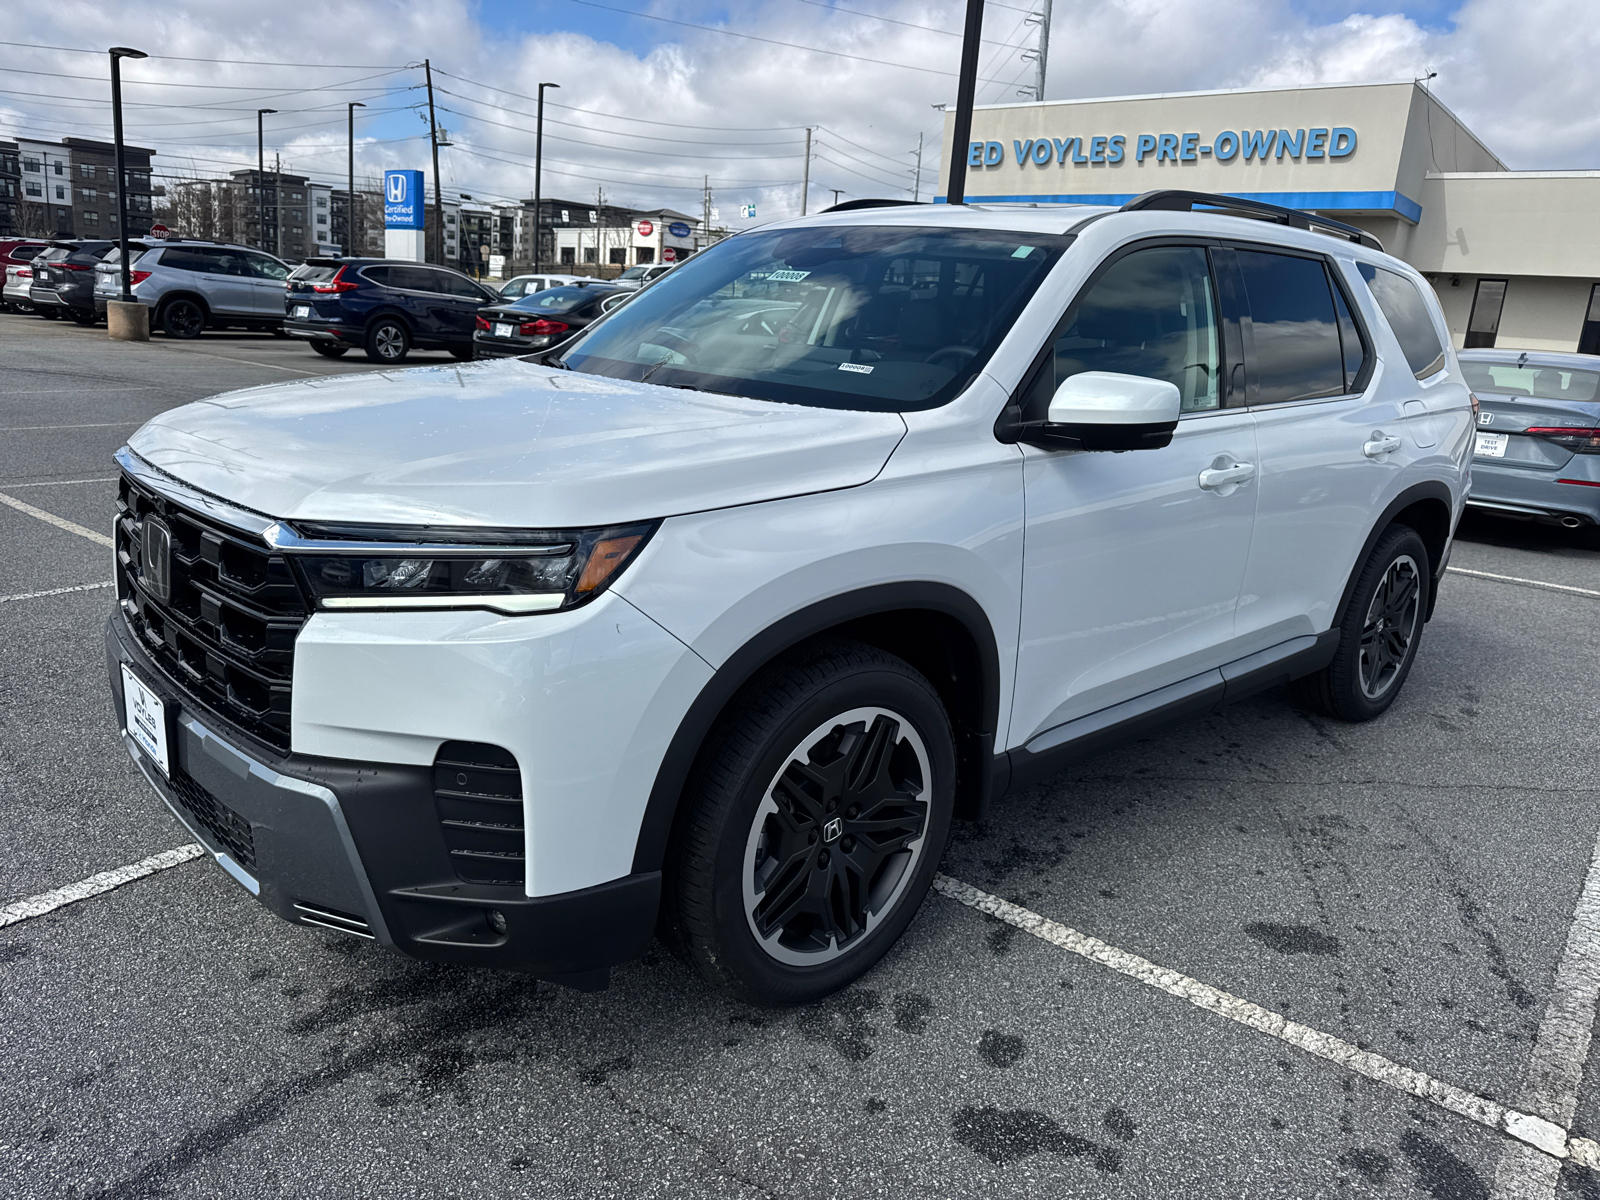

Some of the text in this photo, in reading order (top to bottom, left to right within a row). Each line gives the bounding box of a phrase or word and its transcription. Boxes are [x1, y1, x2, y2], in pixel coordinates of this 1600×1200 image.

[968, 127, 1357, 166] ED VOYLES PRE-OWNED
[384, 205, 413, 214] Certified
[152, 230, 170, 238] STOP
[132, 697, 157, 730] VOYLES
